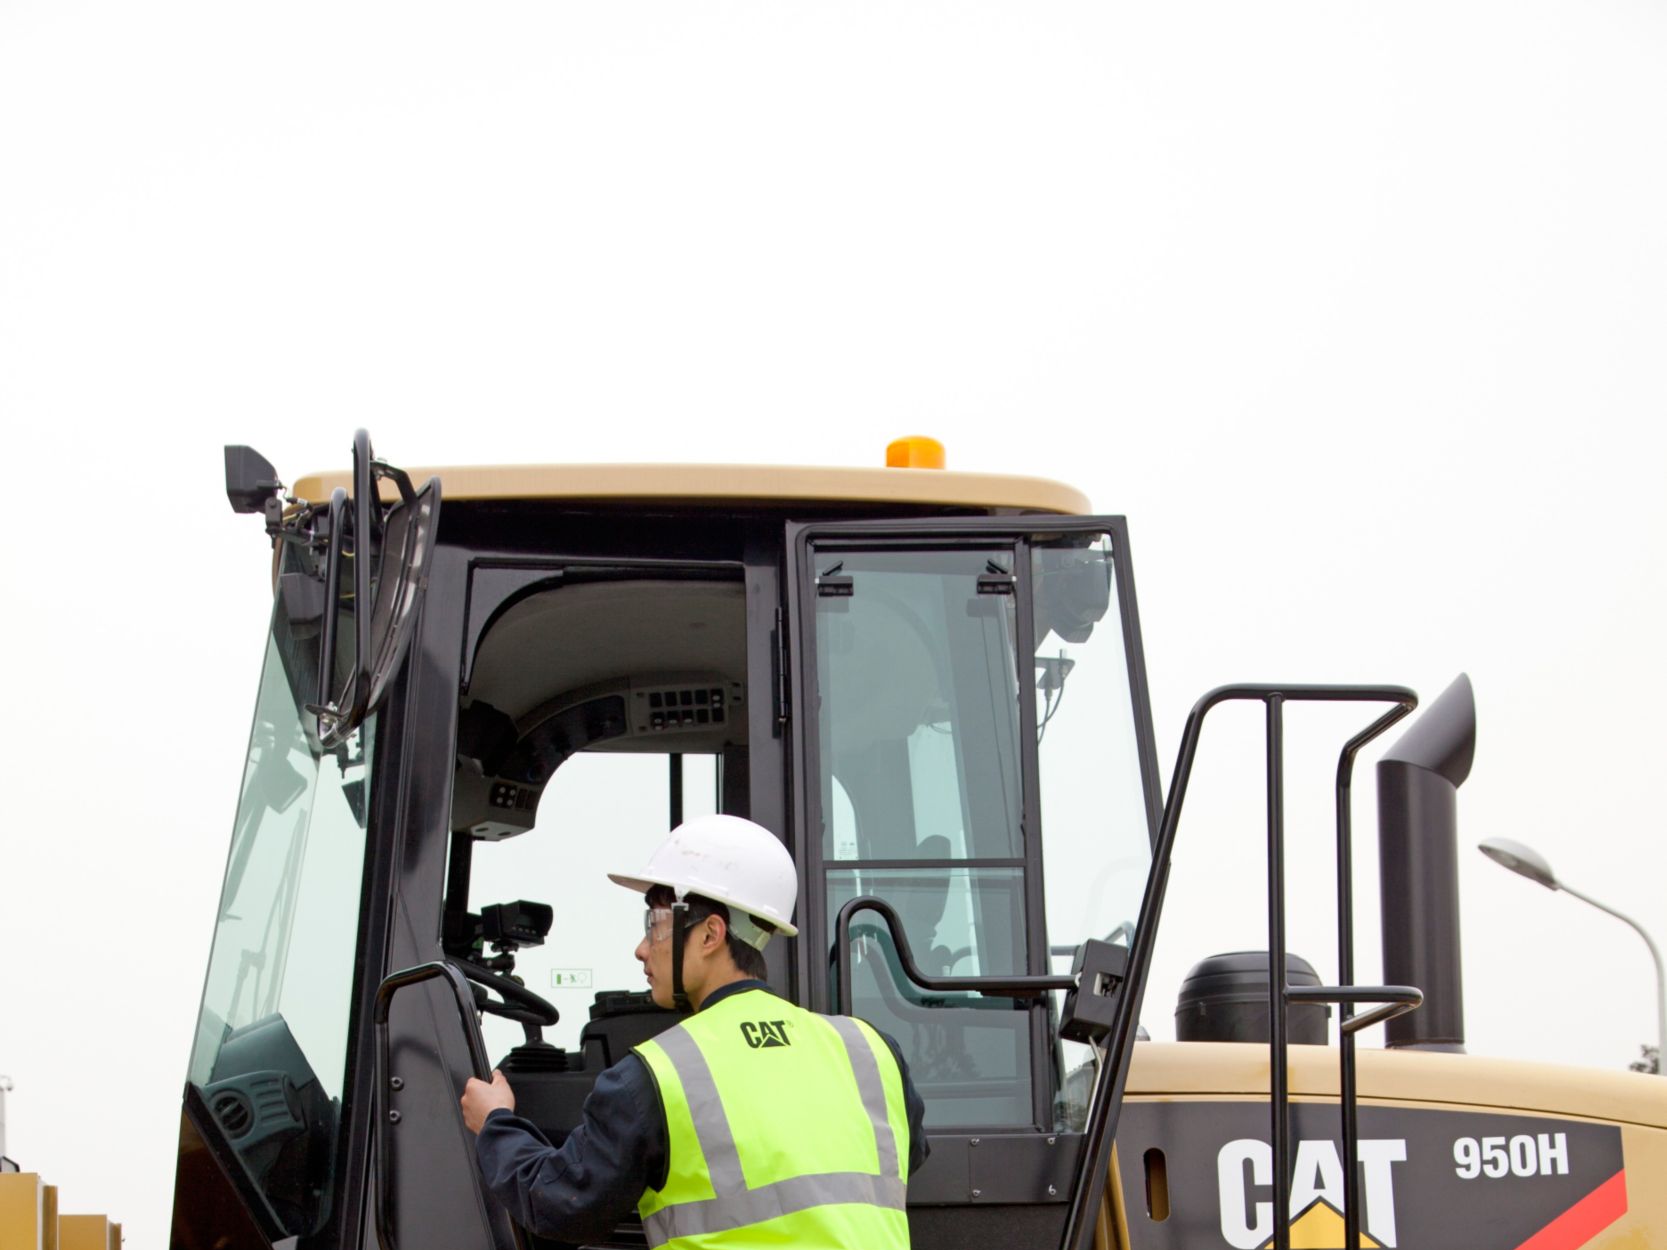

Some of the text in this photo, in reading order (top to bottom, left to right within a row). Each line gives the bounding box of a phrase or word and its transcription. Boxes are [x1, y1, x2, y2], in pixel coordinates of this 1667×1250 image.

[740, 1020, 791, 1049] CAT
[1453, 1133, 1569, 1179] 950H
[1217, 1139, 1407, 1250] CAT
